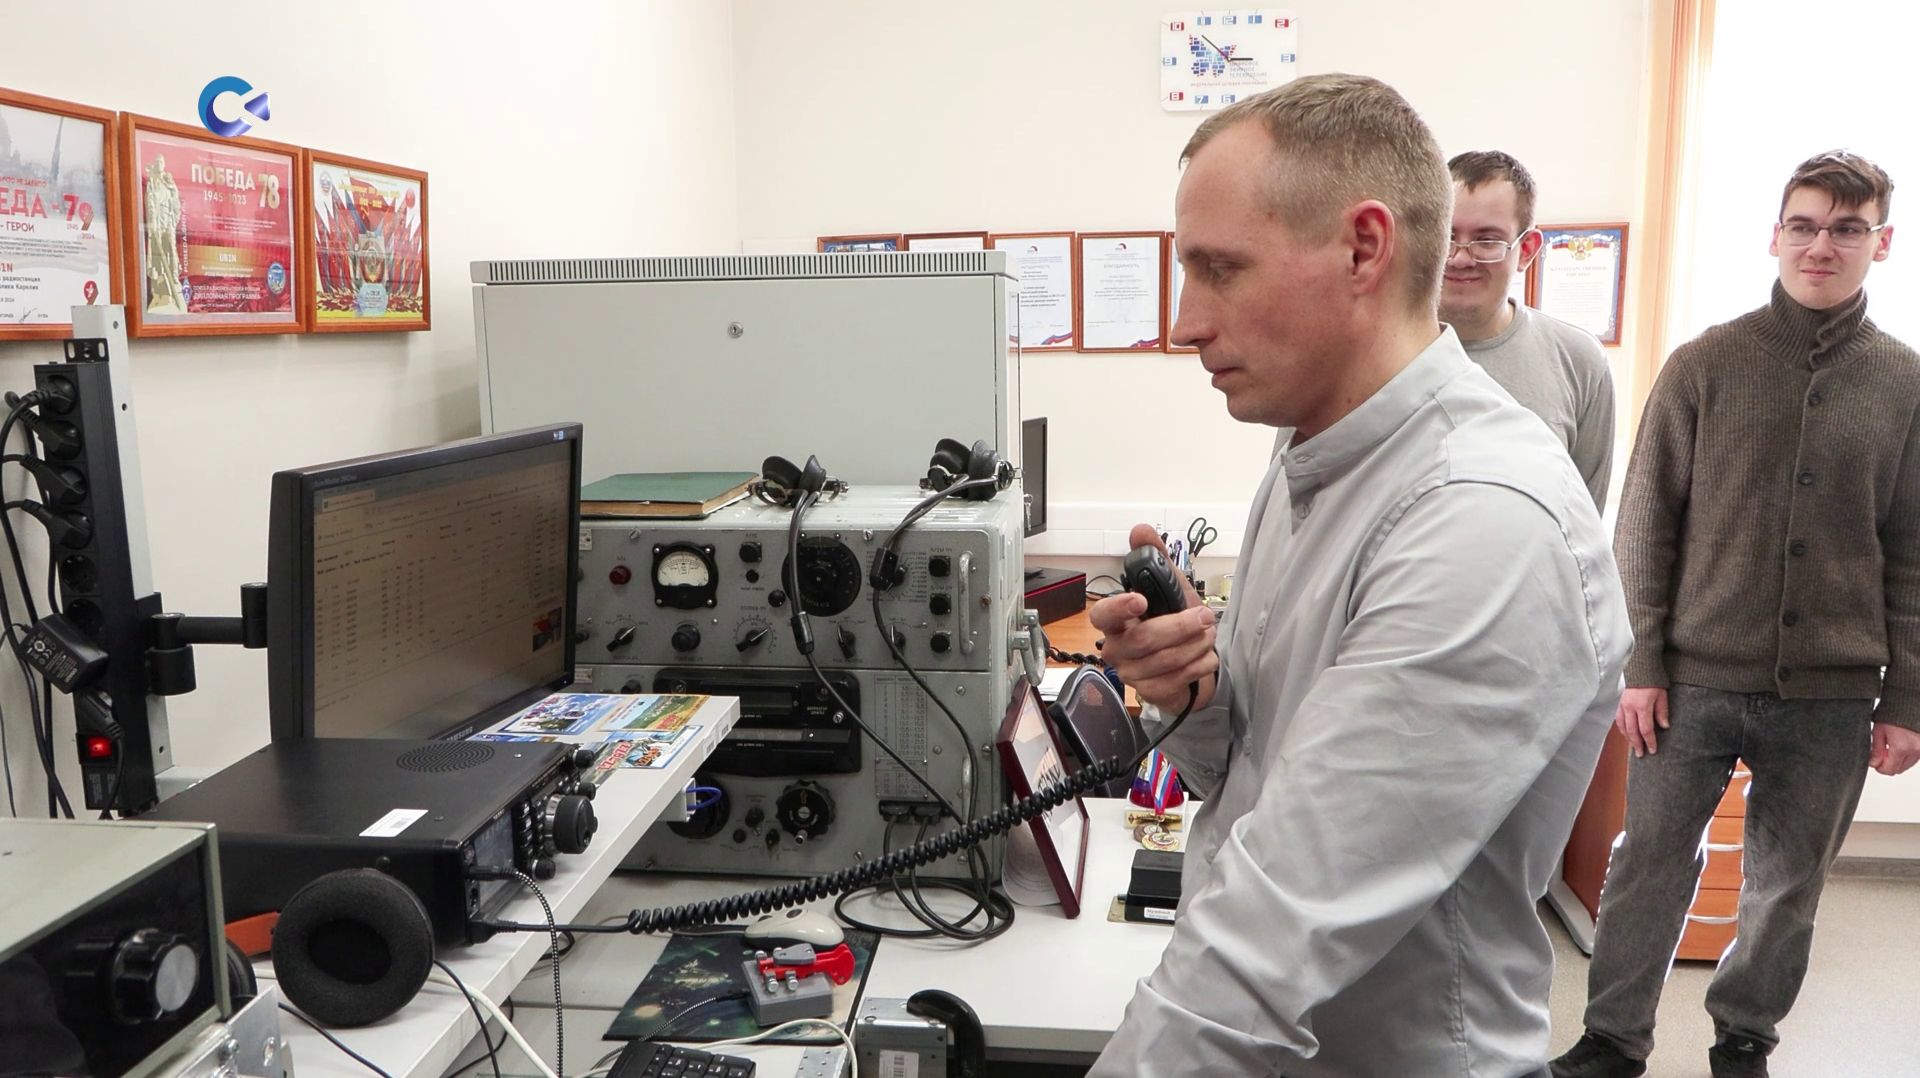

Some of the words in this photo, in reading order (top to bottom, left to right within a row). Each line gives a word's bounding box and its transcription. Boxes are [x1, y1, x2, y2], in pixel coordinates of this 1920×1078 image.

[191, 163, 256, 191] ПОБЕДА
[258, 173, 281, 209] 78
[203, 190, 224, 202] 1945
[63, 194, 94, 231] 79
[6, 221, 35, 232] ГЕРОИ
